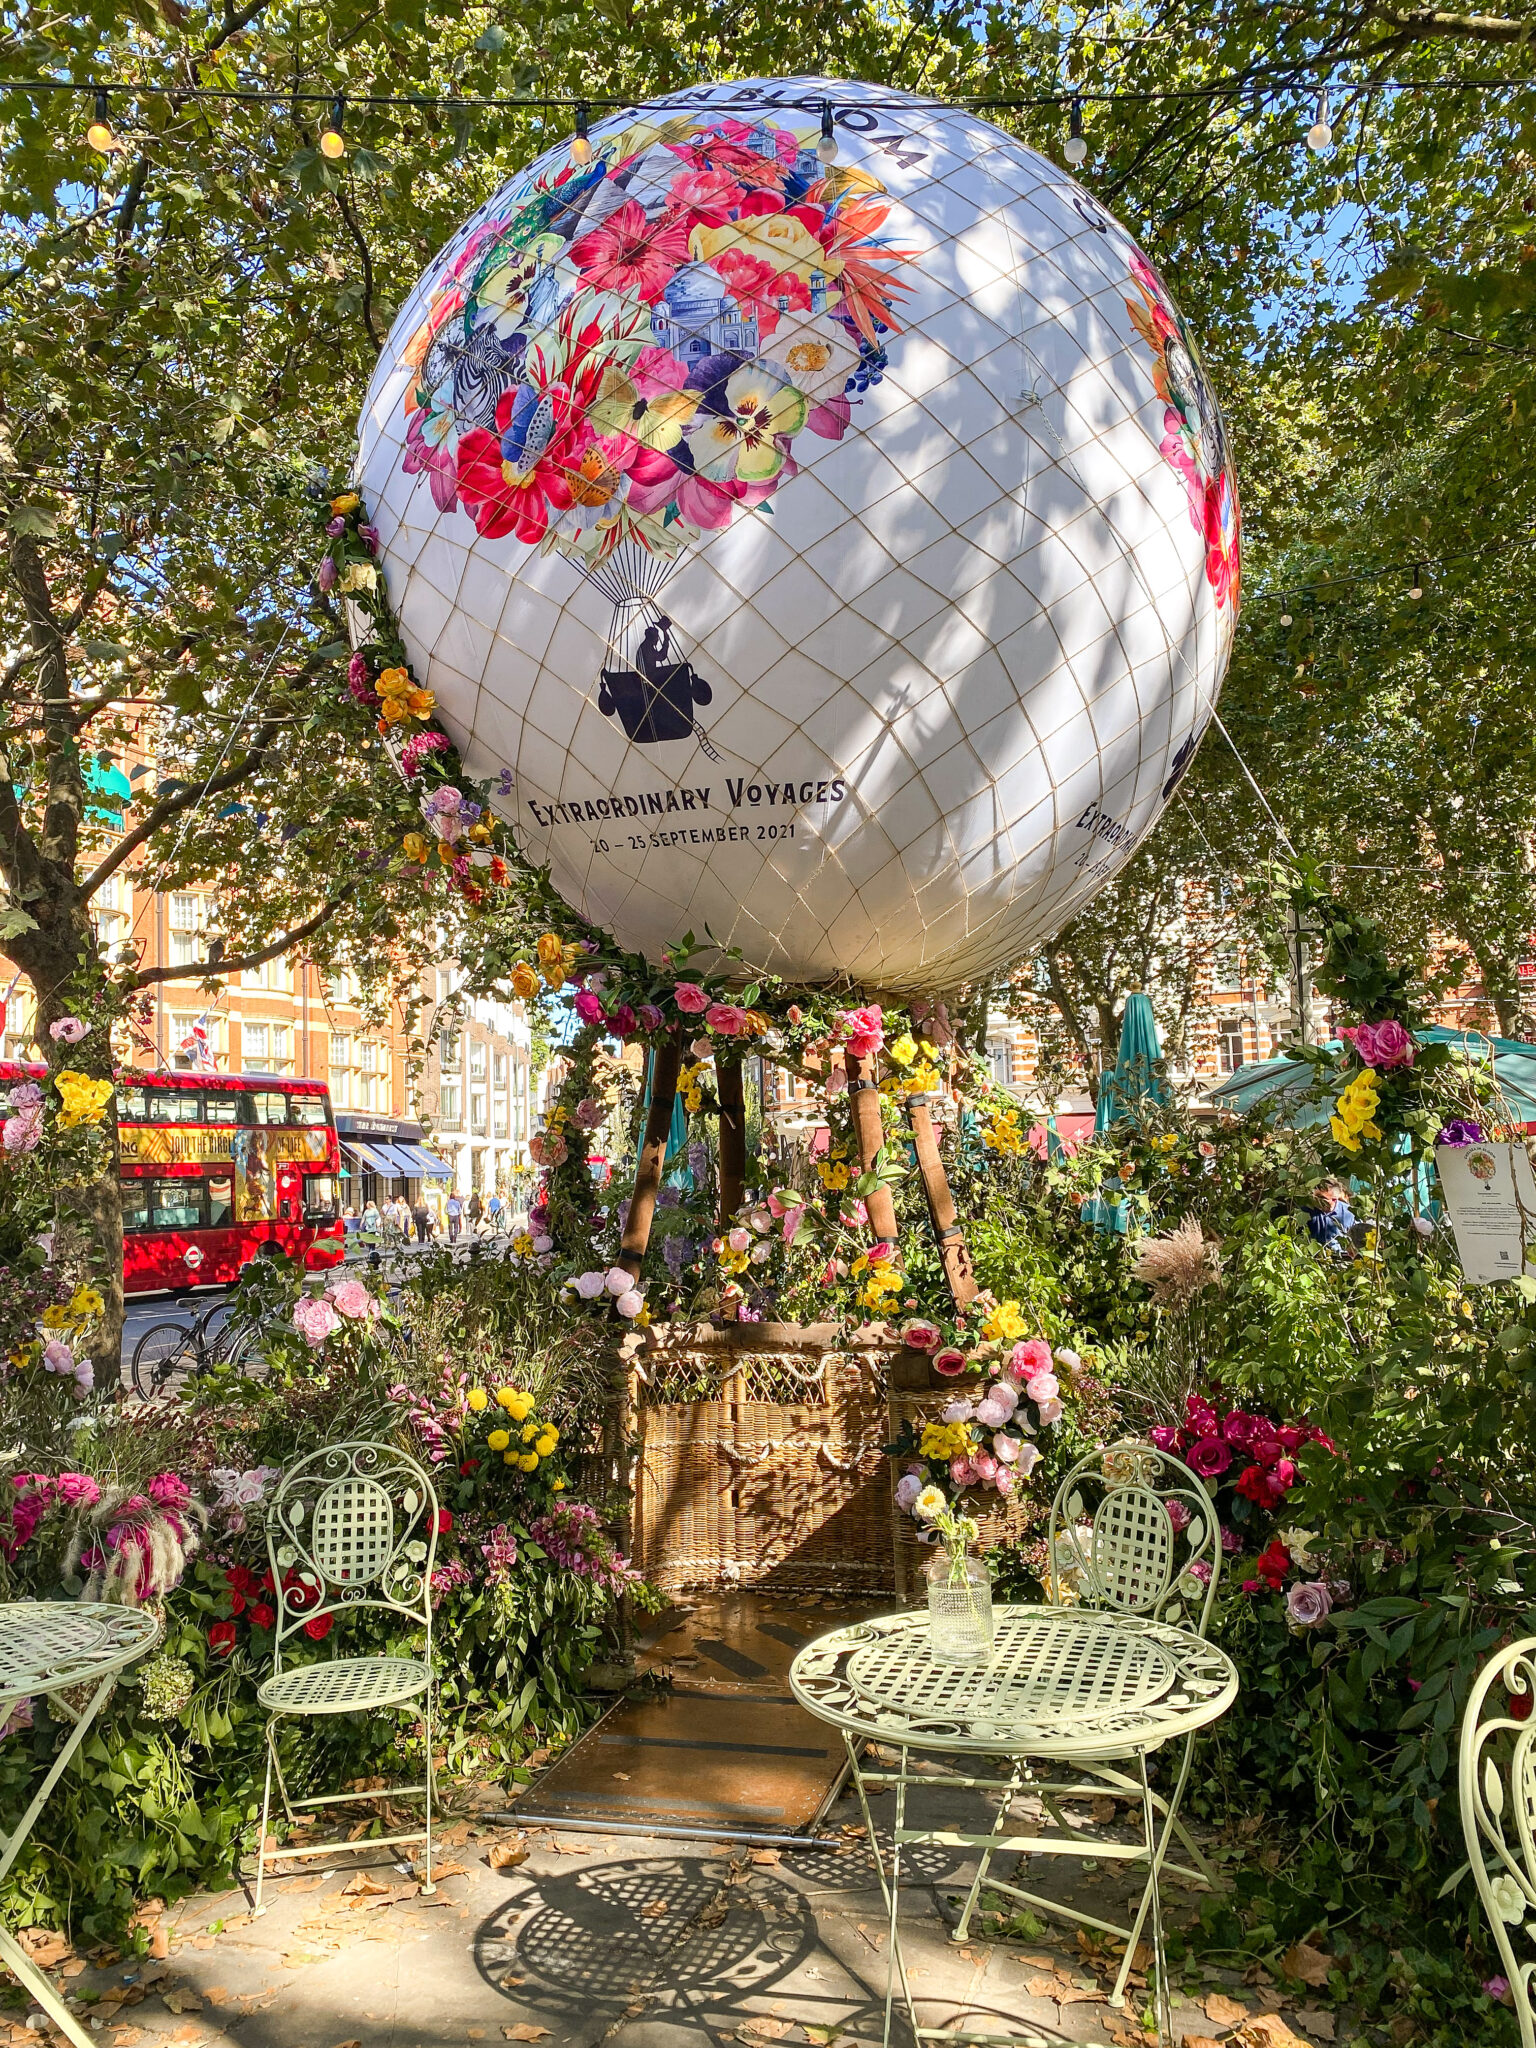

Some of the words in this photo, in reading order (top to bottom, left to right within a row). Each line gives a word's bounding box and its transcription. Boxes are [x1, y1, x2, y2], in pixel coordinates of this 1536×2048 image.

[528, 787, 711, 827] EXTRAORDINARY
[725, 777, 845, 807] VOYAGES
[590, 838, 609, 853] 20
[628, 835, 646, 850] 25
[650, 825, 749, 847] SEPTEMBER
[757, 824, 795, 840] 2021
[171, 1135, 190, 1153] JOIN
[192, 1135, 206, 1153] THE
